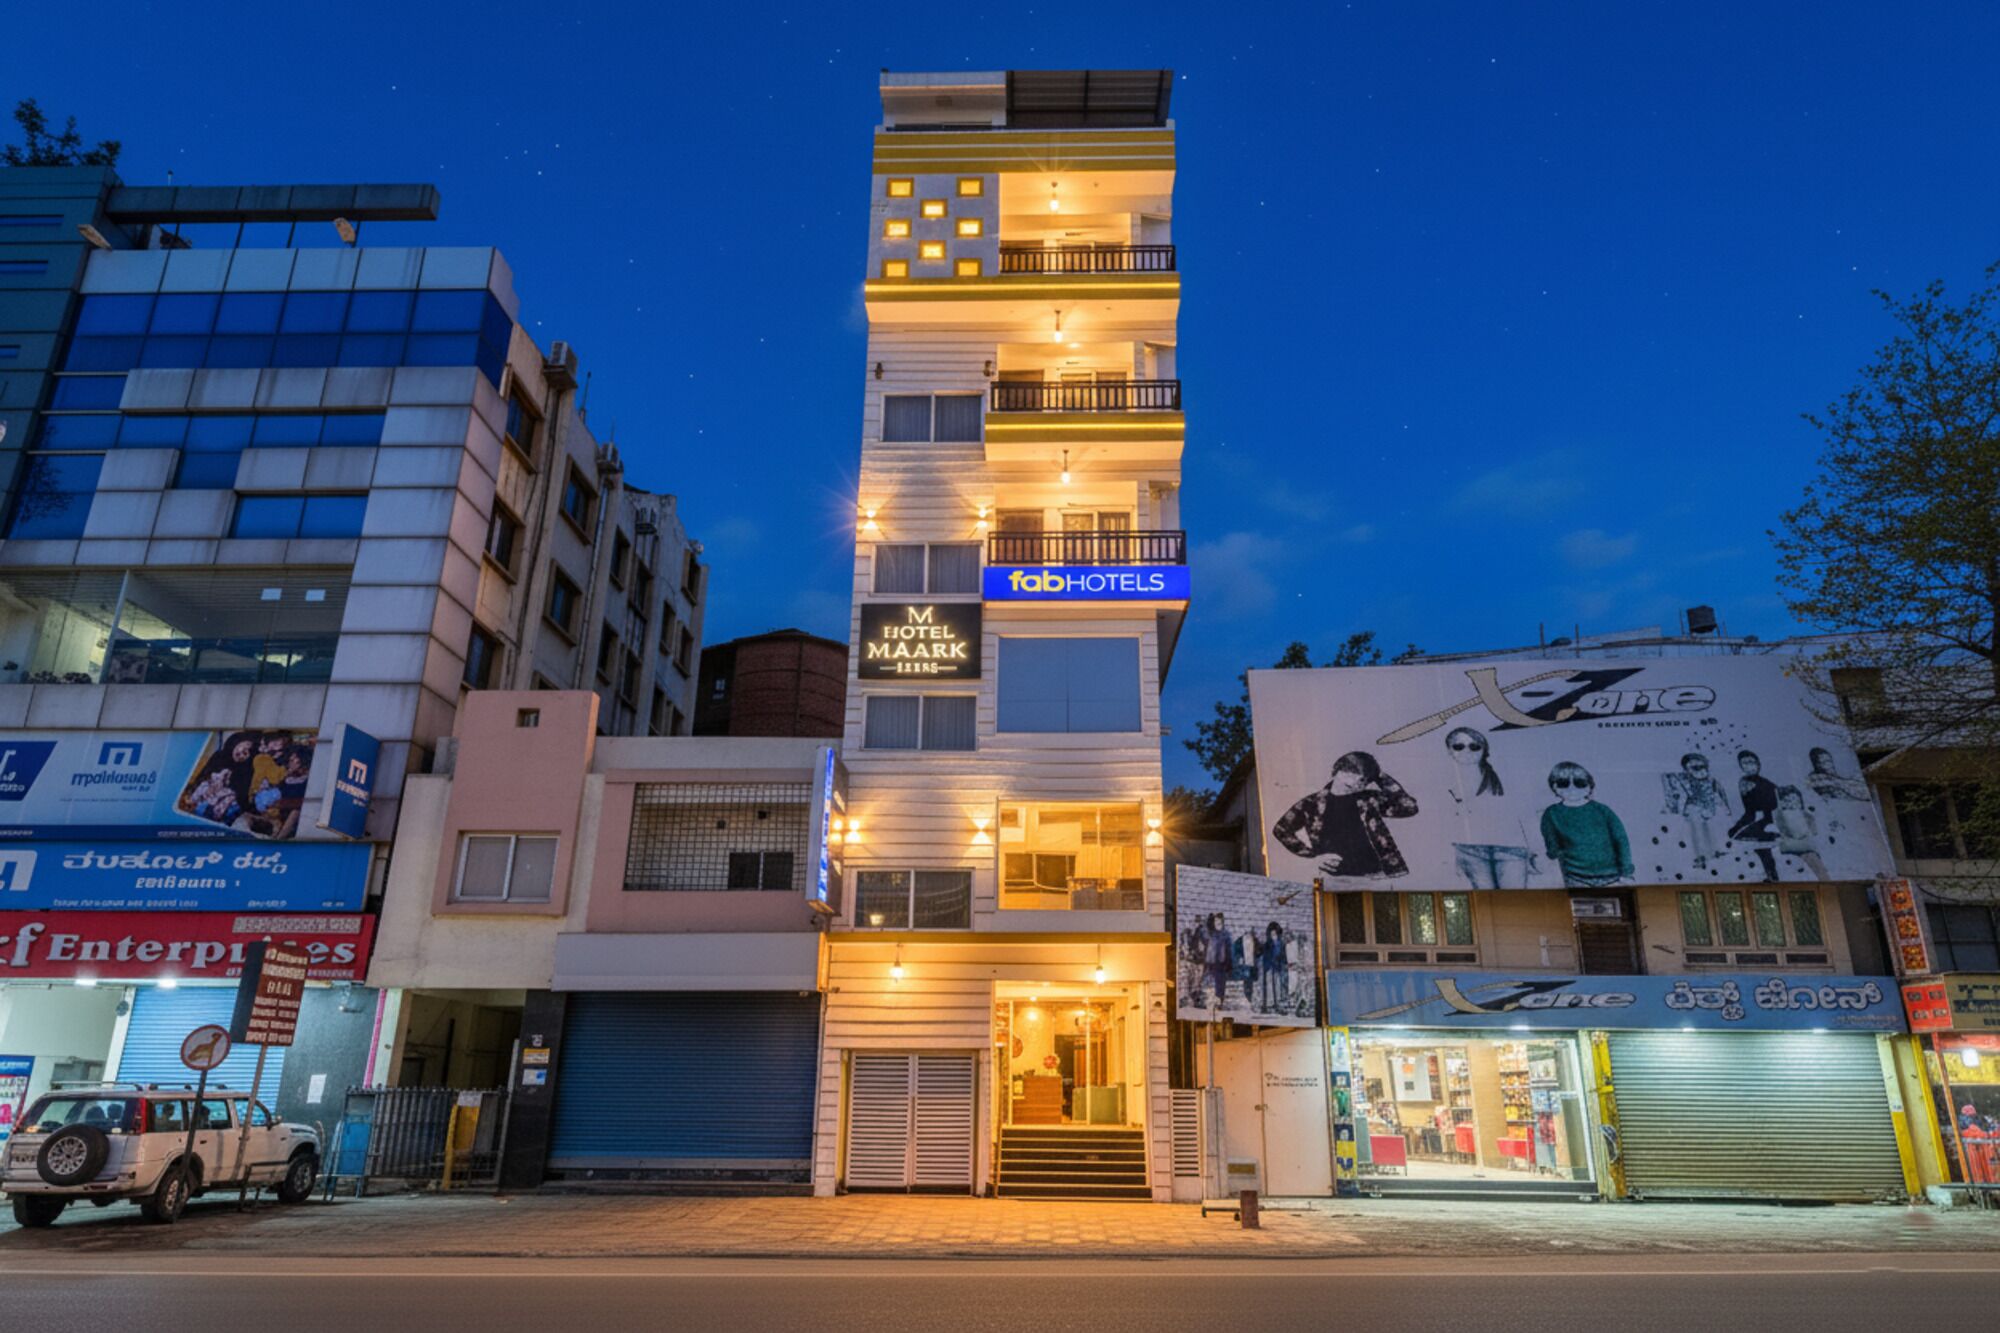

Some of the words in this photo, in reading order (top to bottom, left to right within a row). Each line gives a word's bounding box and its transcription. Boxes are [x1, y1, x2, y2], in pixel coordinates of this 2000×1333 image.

[1008, 570, 1165, 592] fabHOTELS
[883, 625, 955, 640] HOTEL
[867, 642, 967, 659] MAARK
[46, 933, 356, 969] Enterpes
